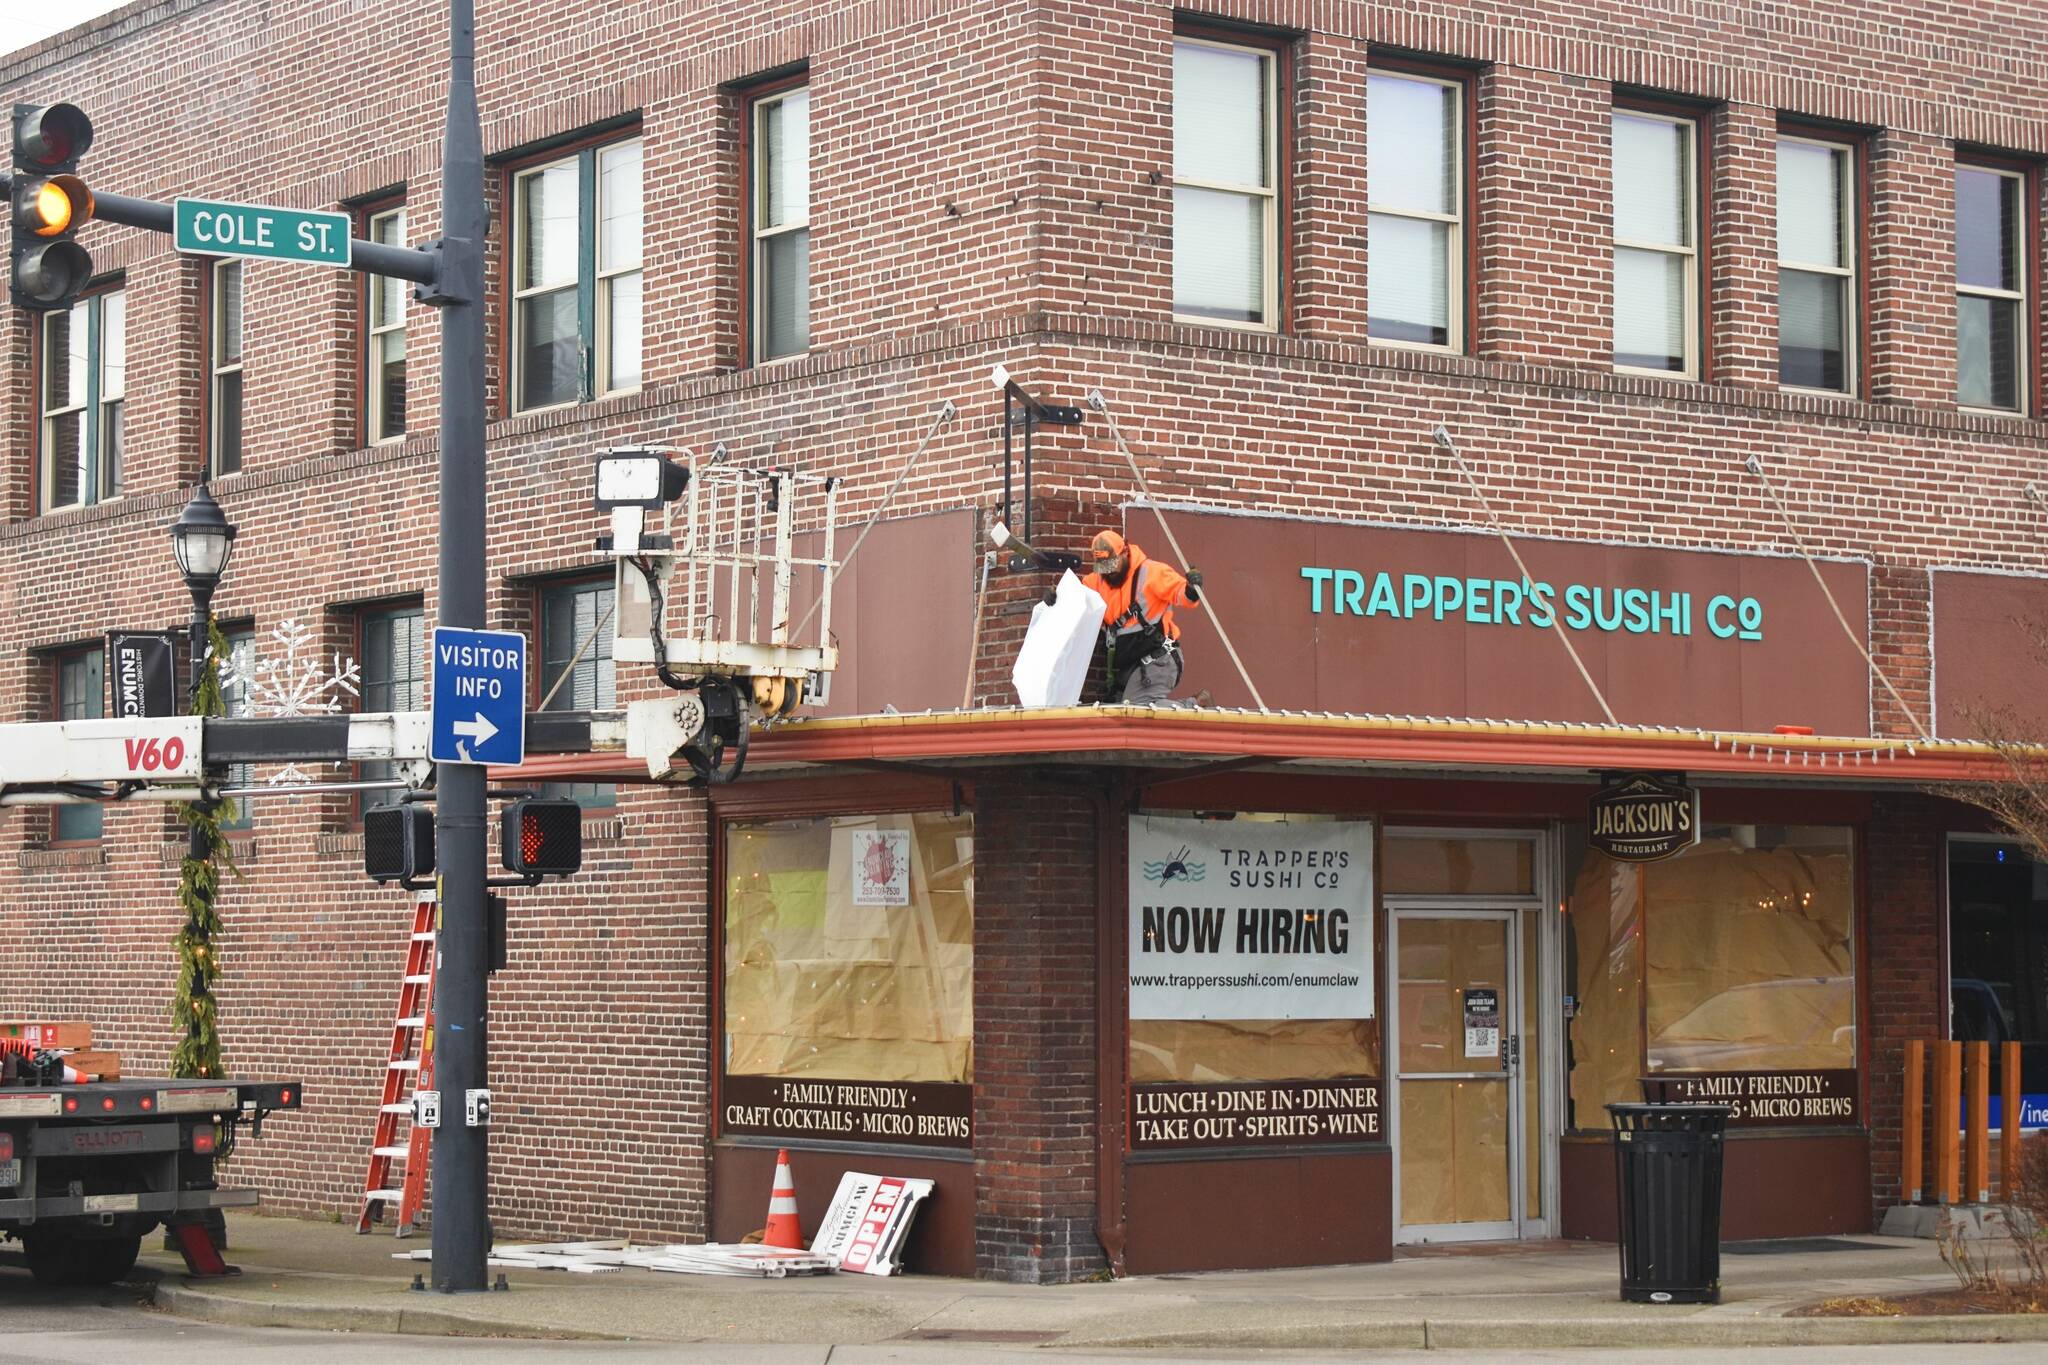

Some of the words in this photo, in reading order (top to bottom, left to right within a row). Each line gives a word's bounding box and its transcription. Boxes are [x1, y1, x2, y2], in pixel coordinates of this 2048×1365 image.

[194, 210, 274, 247] COLE
[298, 221, 335, 253] ST.
[1300, 567, 1556, 629] TRAPPER'S
[1565, 584, 1692, 636] SUSHI
[136, 648, 144, 682] HISTORIC
[440, 644, 519, 670] VISITOR
[138, 684, 146, 717] DOWNTO
[456, 676, 502, 699] INFO
[125, 736, 184, 771] V60
[1593, 800, 1690, 835] JACKSON'S
[1220, 849, 1349, 868] TRAPPER'S
[1611, 843, 1669, 854] RESTAURANT
[1230, 870, 1302, 888] SUSHI
[1142, 906, 1226, 954] NOW
[1236, 908, 1349, 954] HIRING
[1130, 972, 1359, 990] www.trapperssushi.com/enumclaw
[783, 1082, 835, 1105] FAMILY
[838, 1085, 908, 1109] FRIENDLY
[1749, 1075, 1823, 1095] FRIENDLY
[1136, 1092, 1207, 1115] LUNCH
[1217, 1090, 1267, 1112] DINE
[1271, 1090, 1294, 1110] IN
[1302, 1087, 1379, 1109] DINNER
[1750, 1098, 1801, 1117] MICRO
[1804, 1097, 1852, 1116] BREWS
[726, 1105, 771, 1127] CRAFT
[773, 1107, 853, 1132] COCKTAILS
[862, 1111, 913, 1136] MICRO
[918, 1114, 969, 1138] BREWS
[1136, 1119, 1190, 1142] TAKE
[1194, 1118, 1236, 1140] OUT
[1246, 1114, 1319, 1137] SPIRITS
[1328, 1112, 1378, 1135] WINE
[847, 1184, 900, 1265] OPEN
